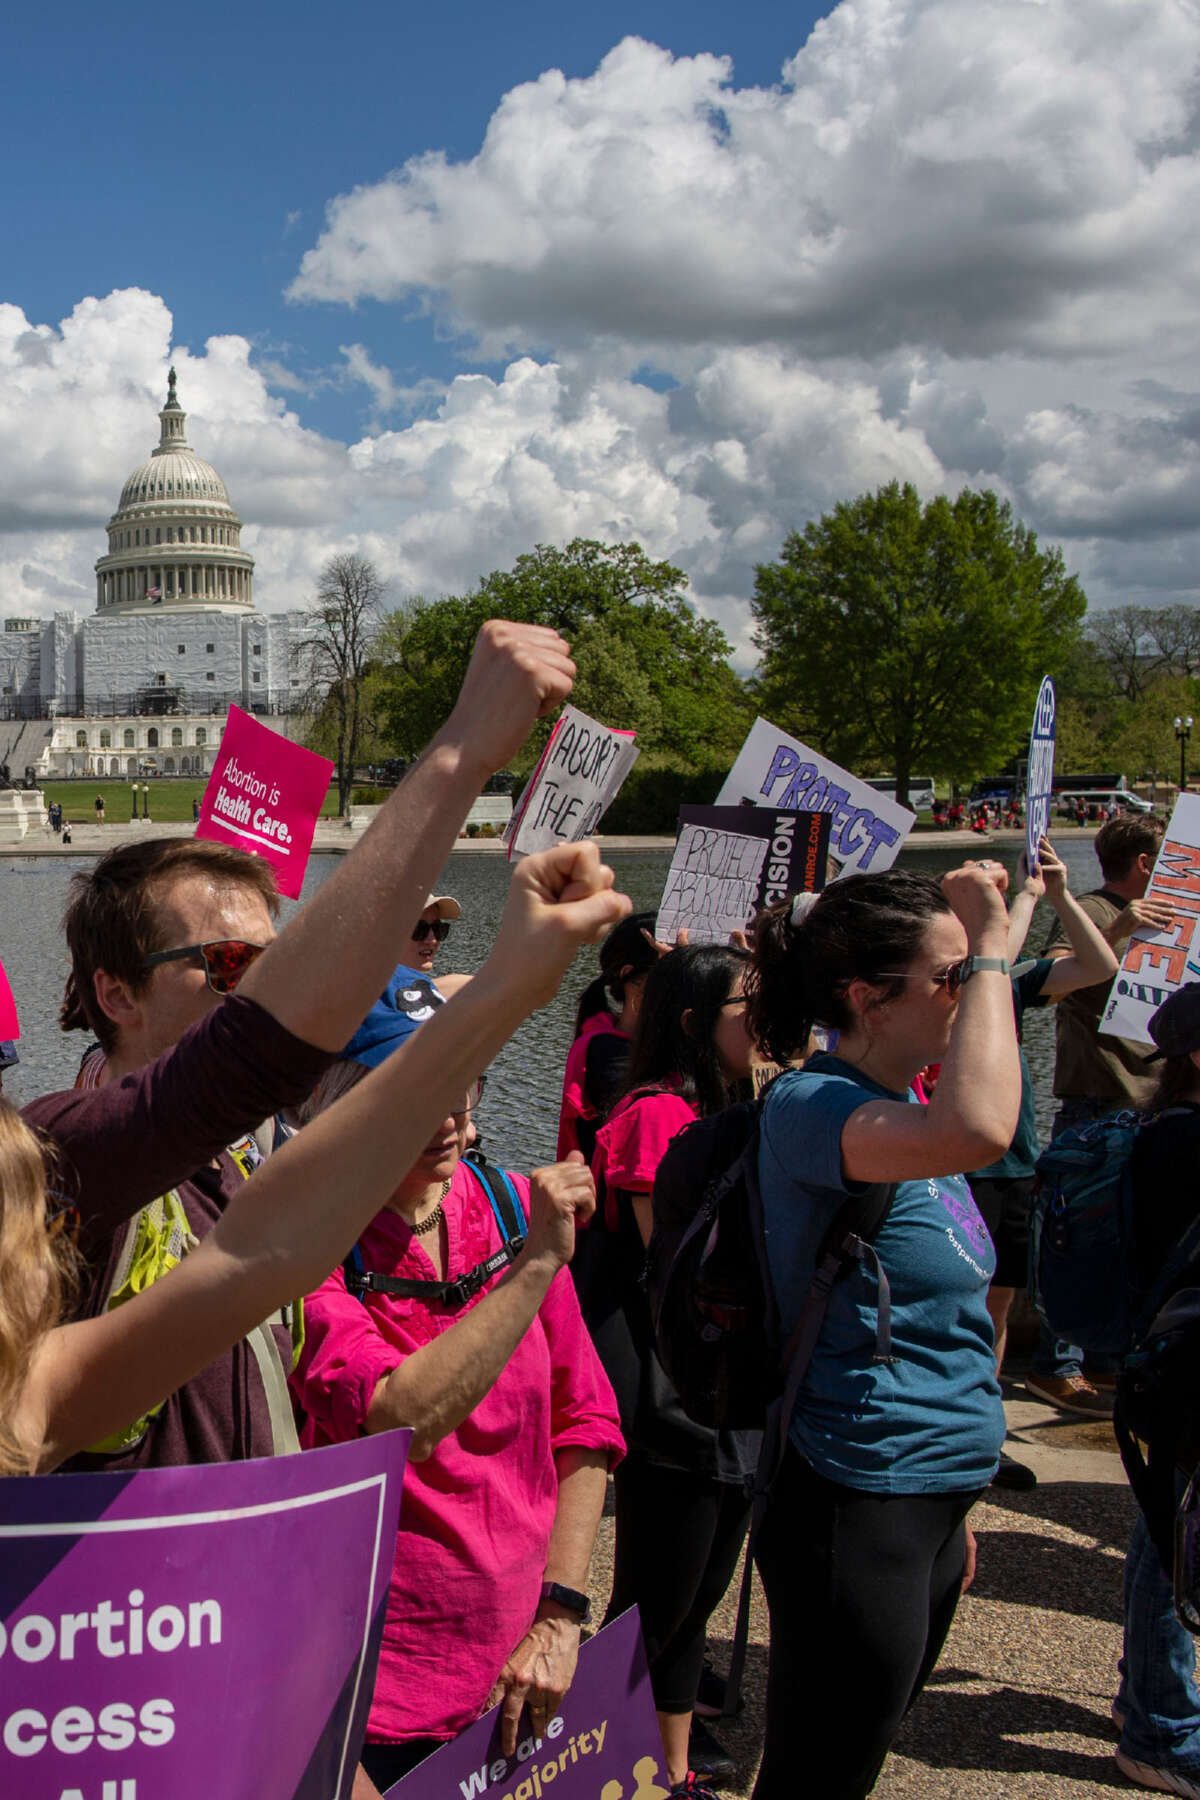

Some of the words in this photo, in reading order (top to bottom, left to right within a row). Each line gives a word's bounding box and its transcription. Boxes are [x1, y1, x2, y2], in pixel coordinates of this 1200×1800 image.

[222, 757, 267, 800] Abortion
[268, 782, 280, 806] is
[552, 723, 620, 788] ABORT
[214, 785, 251, 825] Health
[253, 807, 292, 844] Care.
[533, 781, 583, 838] THE
[760, 745, 900, 870] PROTECT
[458, 1757, 507, 1800] We
